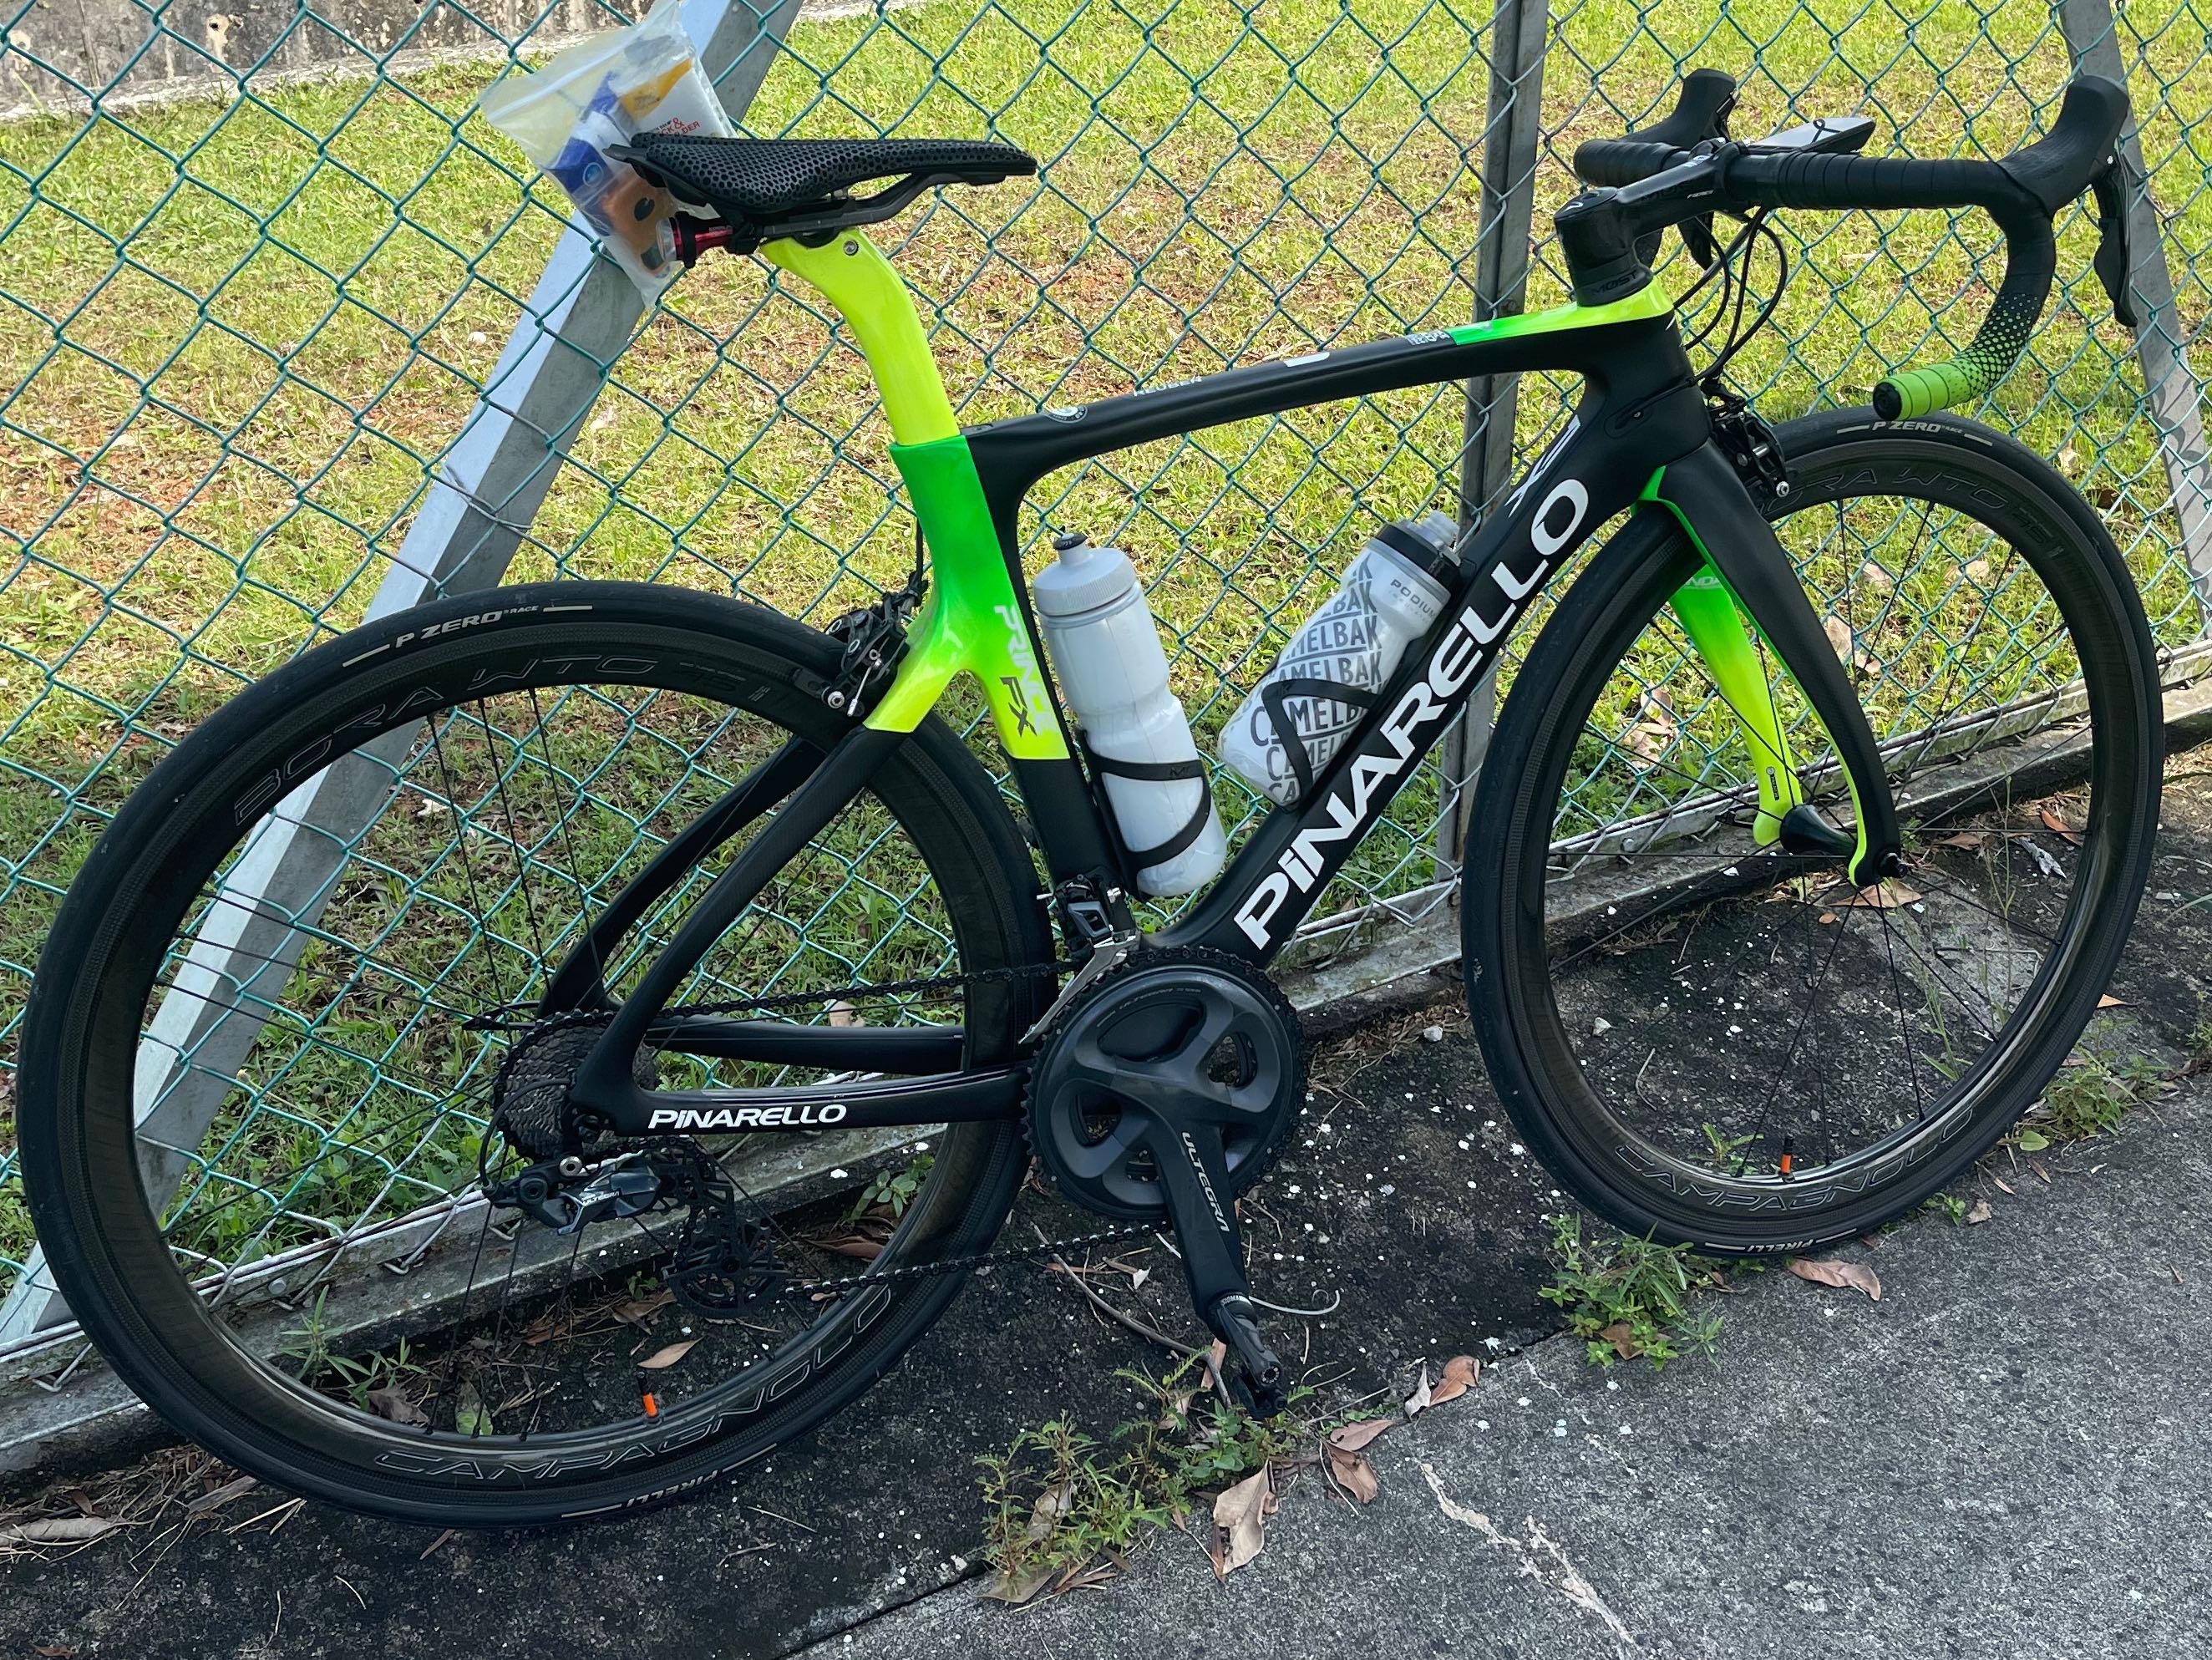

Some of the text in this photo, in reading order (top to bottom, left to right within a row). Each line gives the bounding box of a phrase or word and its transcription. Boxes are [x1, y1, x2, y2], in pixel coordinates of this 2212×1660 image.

[1888, 421, 1941, 434] ZERO
[1761, 468, 1878, 515] ORA
[394, 632, 416, 649] P
[419, 610, 504, 641] ZERO
[993, 604, 1058, 738] PRINCE
[999, 675, 1038, 739] FX
[1233, 478, 1589, 951] PINARELLO
[233, 684, 444, 827] BORA
[467, 655, 660, 691] WTO
[647, 1104, 847, 1129] PINARELLO
[1181, 1131, 1230, 1232] ULTEGRA
[1615, 1108, 1973, 1211] CAMPAGNOLO
[1746, 1238, 1814, 1253] PIRELLI
[373, 1283, 892, 1482] CAMPAGNOLO
[626, 1469, 718, 1508] PIRELLI
